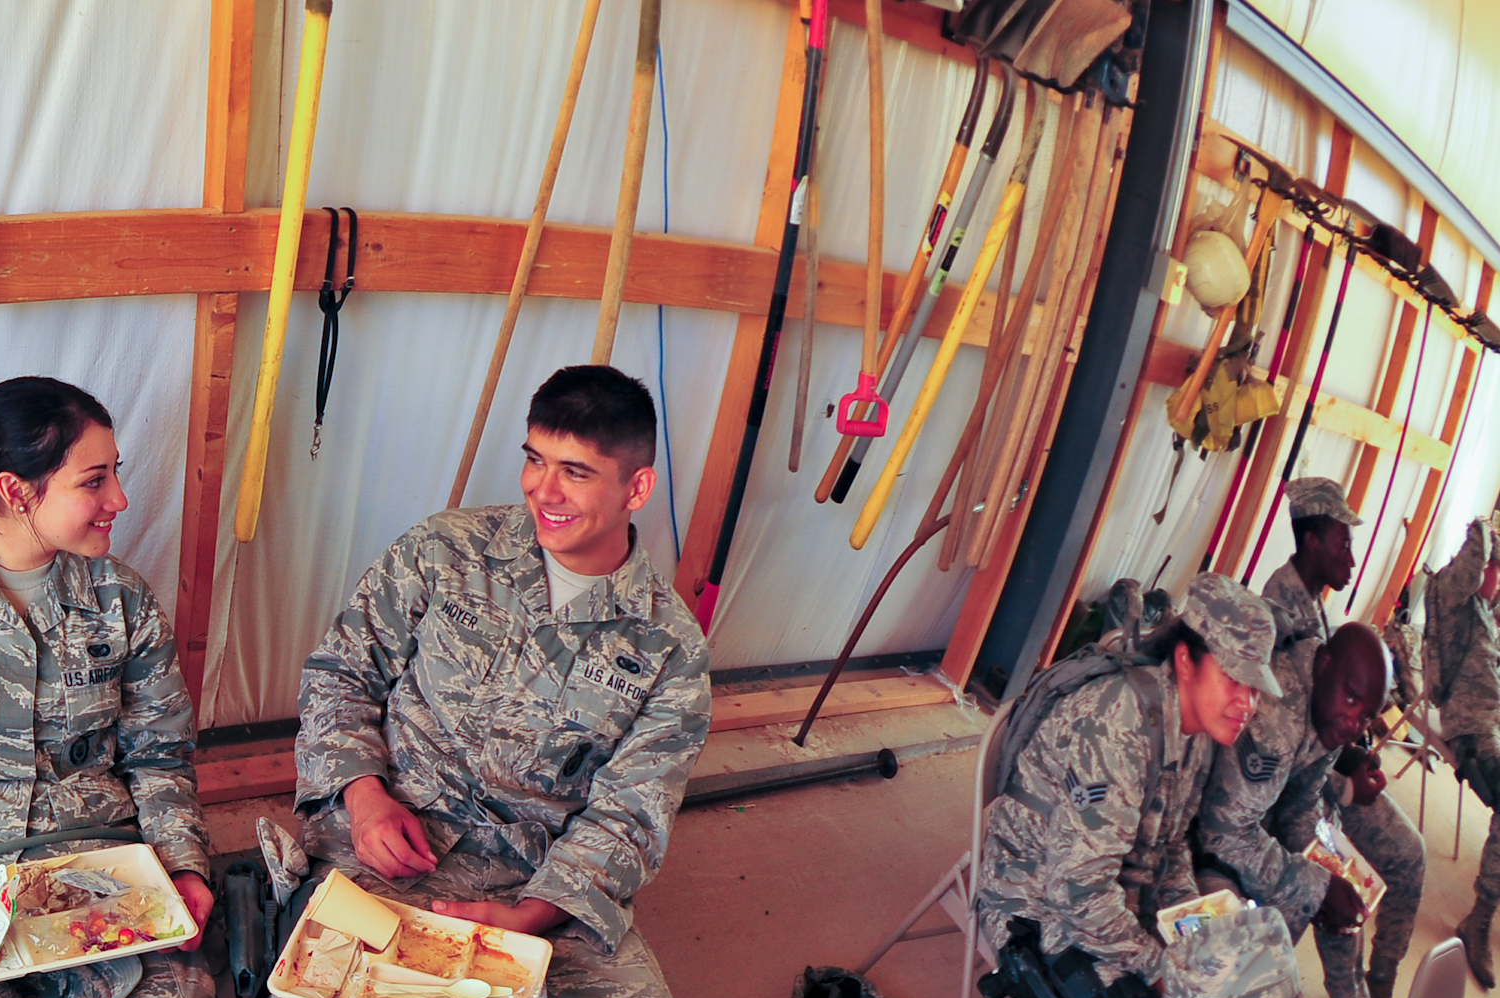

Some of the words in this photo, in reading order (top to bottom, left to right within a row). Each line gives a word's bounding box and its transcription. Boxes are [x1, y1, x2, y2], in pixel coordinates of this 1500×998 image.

[441, 600, 479, 630] HOYER
[64, 672, 88, 687] U.S.
[88, 668, 104, 685] AIR
[584, 665, 604, 685] U.S.
[606, 674, 627, 696] AIR
